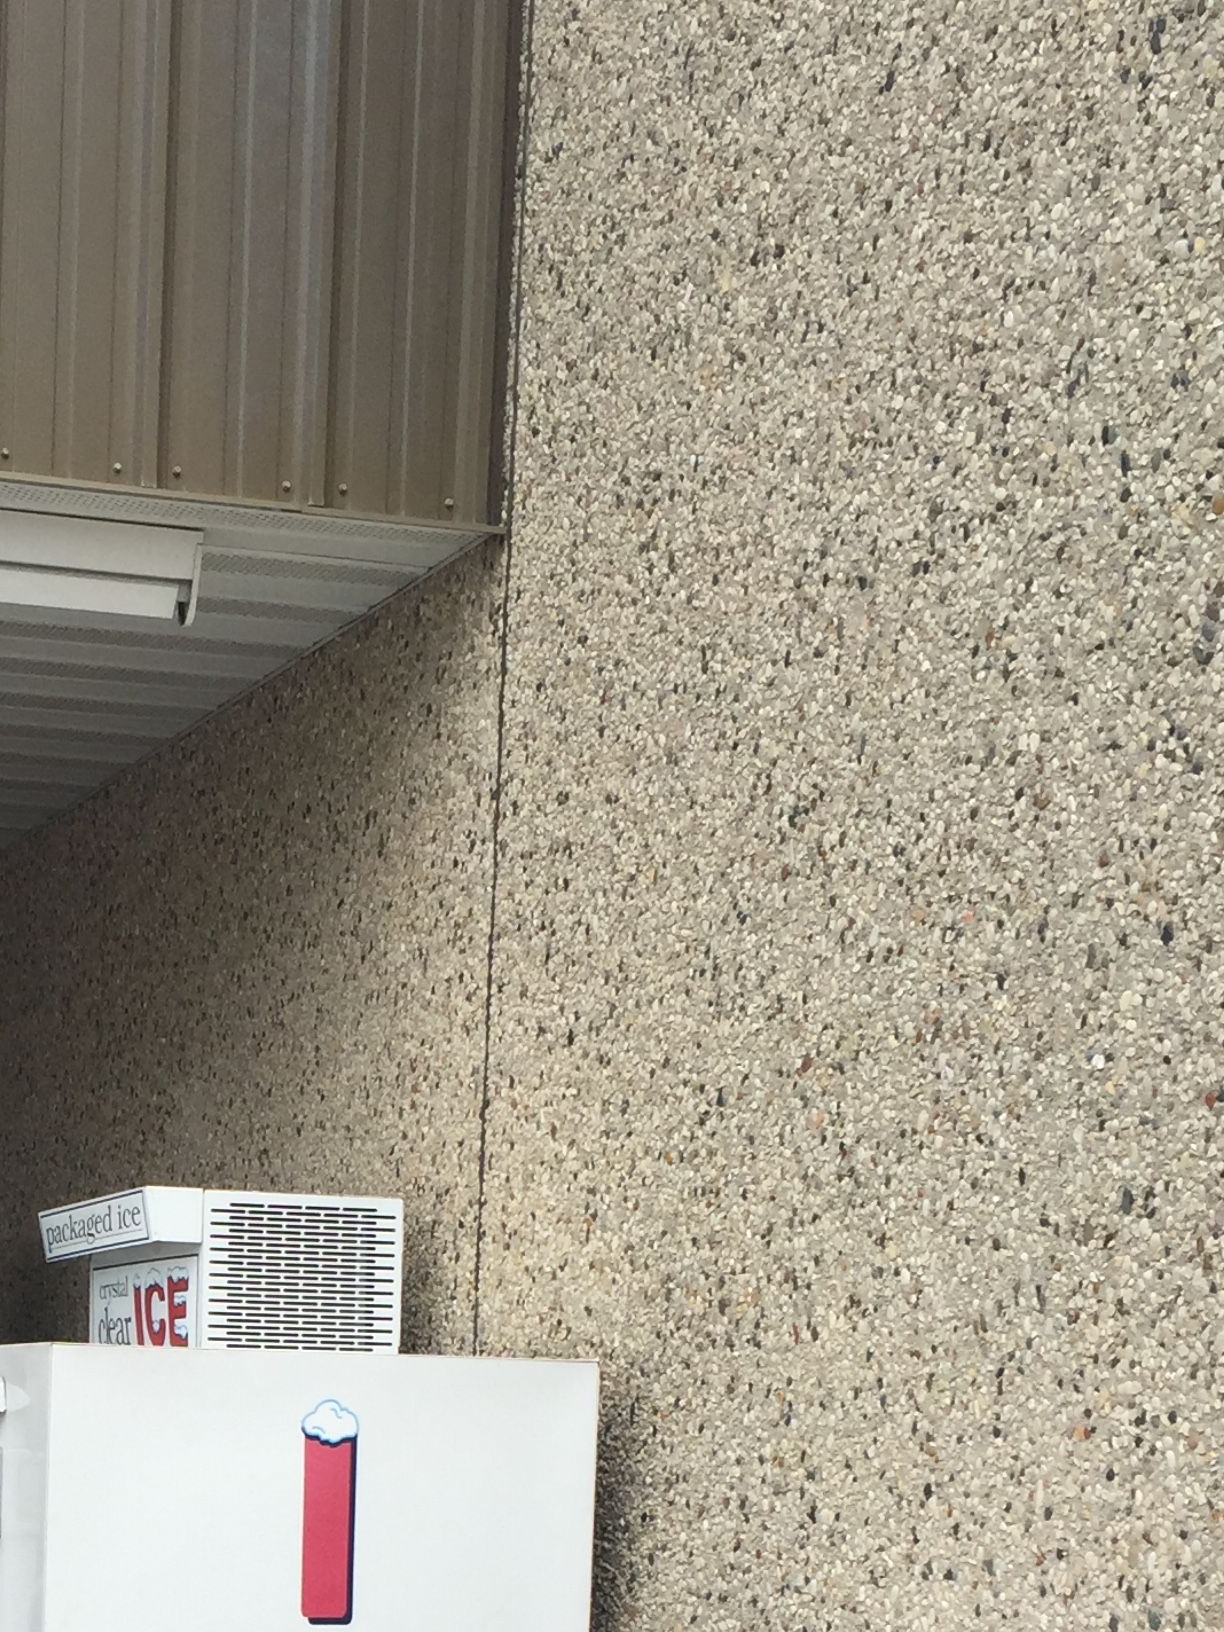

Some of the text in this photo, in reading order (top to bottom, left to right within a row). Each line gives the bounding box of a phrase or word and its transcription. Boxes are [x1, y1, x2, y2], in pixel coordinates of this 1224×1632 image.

[46, 1205, 141, 1253] packaged ice
[99, 1276, 128, 1306] crystal
[132, 1265, 190, 1347] ICE
[98, 1306, 132, 1345] clear
